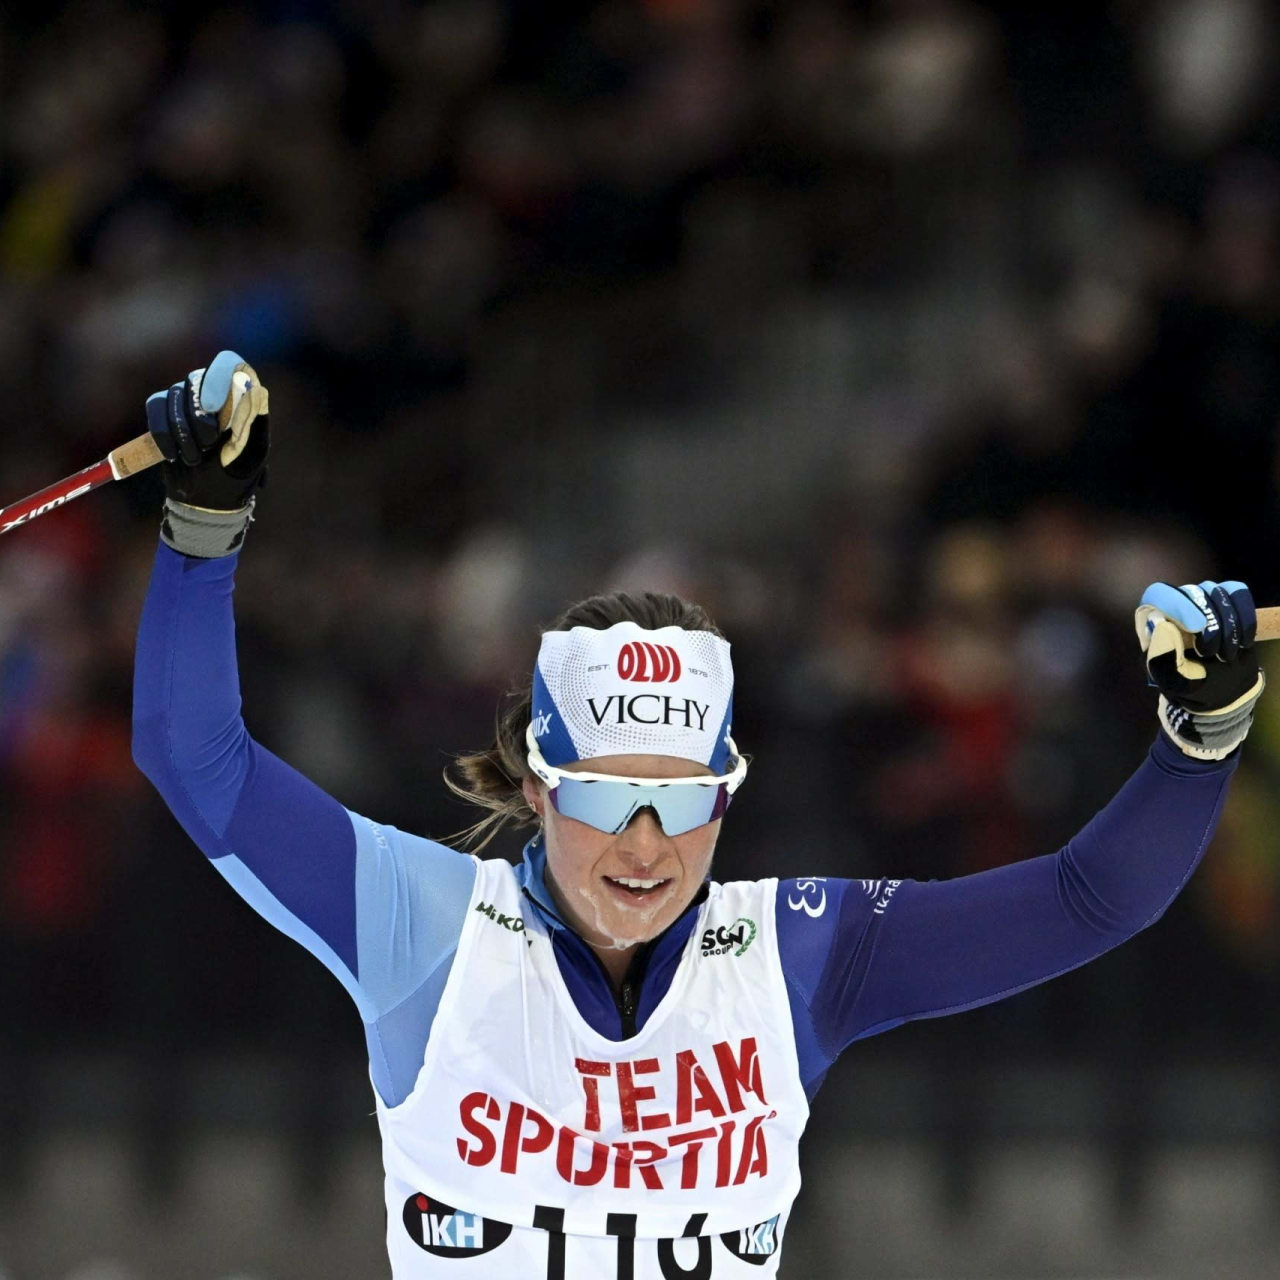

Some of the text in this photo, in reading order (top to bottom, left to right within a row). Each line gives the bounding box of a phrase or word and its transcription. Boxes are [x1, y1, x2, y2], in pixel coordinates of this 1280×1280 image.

[586, 694, 710, 731] VICHY
[702, 943, 733, 957] GROUP
[575, 1037, 770, 1134] TEAM
[456, 1091, 777, 1190] SPORTIA
[418, 1206, 484, 1249] IKH
